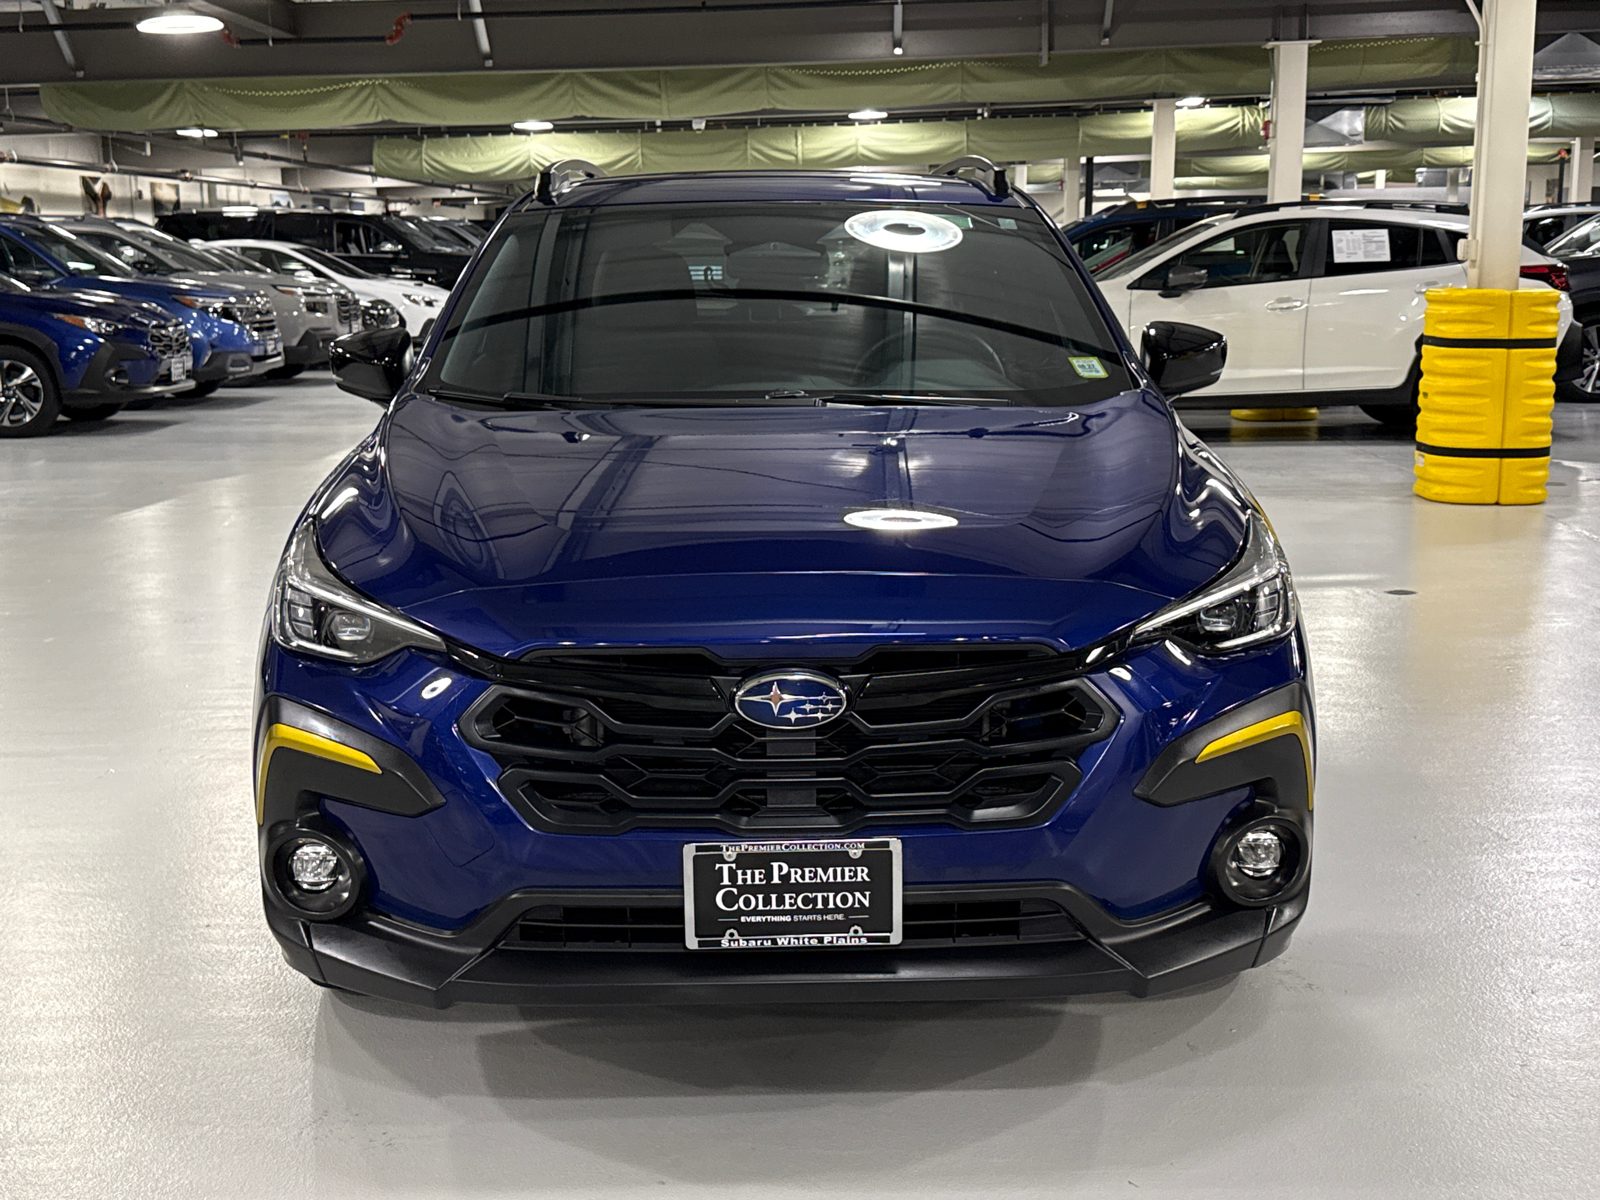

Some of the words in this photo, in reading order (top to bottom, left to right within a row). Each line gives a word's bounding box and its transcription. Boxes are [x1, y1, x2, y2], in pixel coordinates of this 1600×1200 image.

[715, 863, 767, 886] THE
[770, 861, 871, 884] PREMIER
[715, 887, 872, 911] COLLECTION
[740, 914, 792, 923] EVERYTHING
[793, 914, 822, 922] STARTS
[720, 938, 772, 948] Subaru
[776, 936, 819, 946] White
[823, 935, 868, 945] Plains
